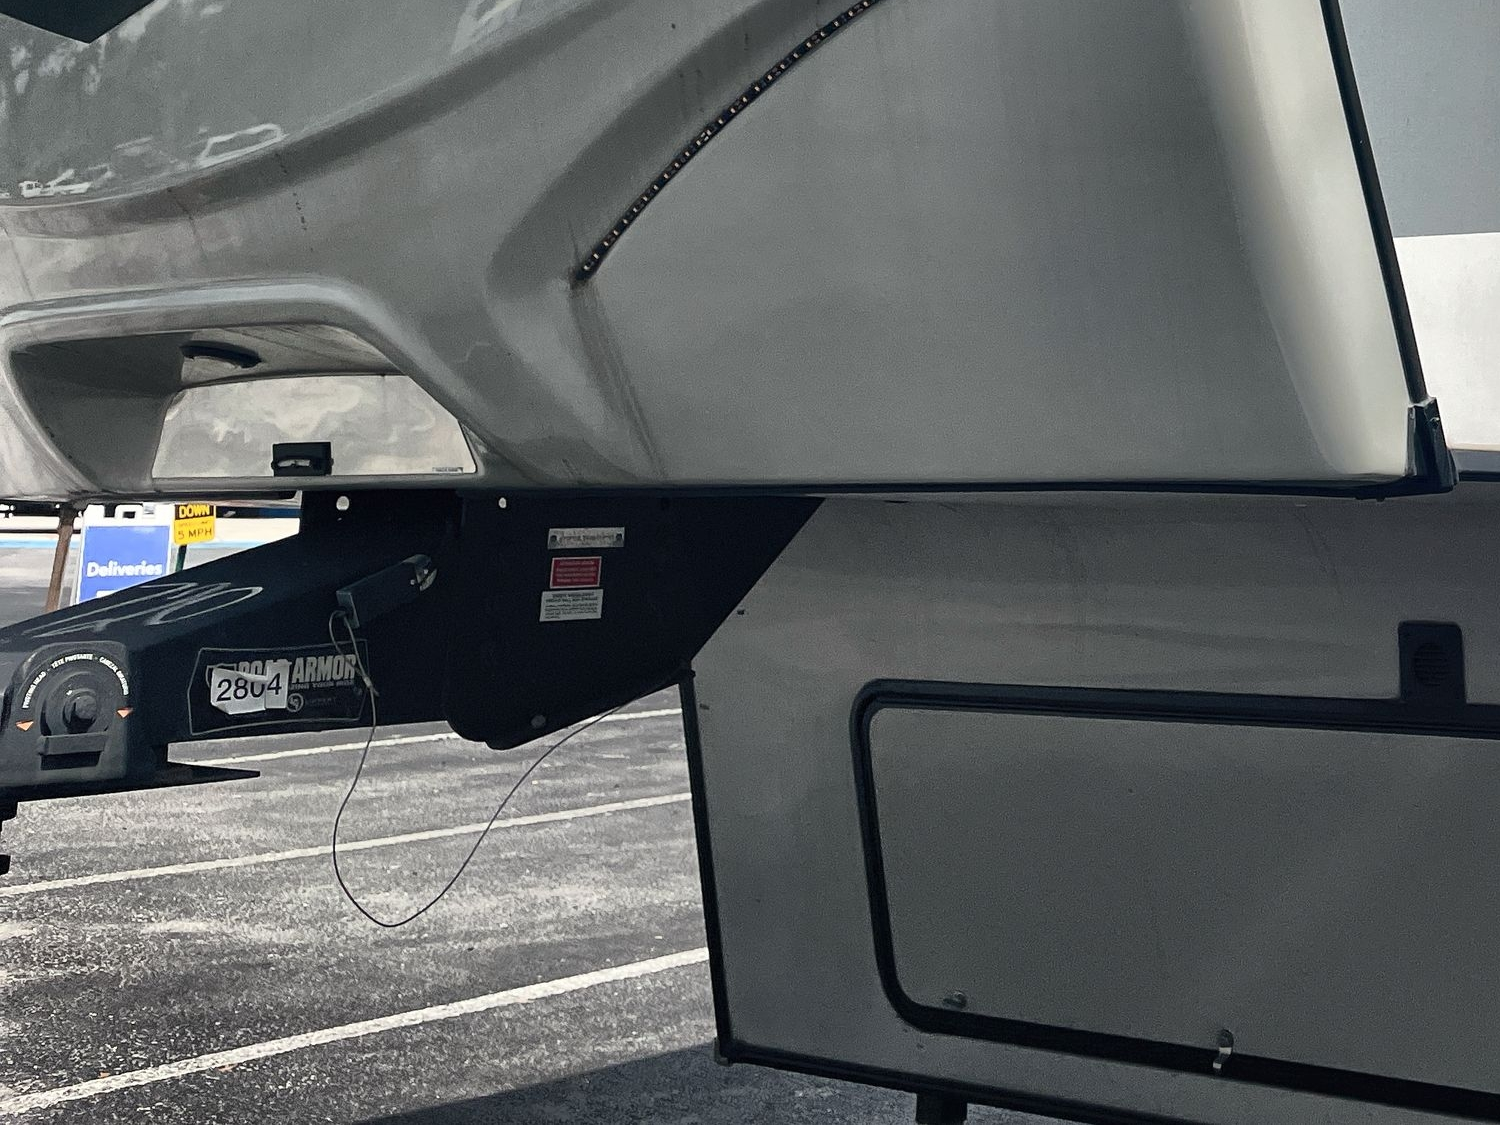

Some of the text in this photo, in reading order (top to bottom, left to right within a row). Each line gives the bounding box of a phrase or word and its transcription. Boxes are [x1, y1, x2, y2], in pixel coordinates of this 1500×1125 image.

[178, 504, 211, 519] DOWN
[188, 527, 213, 539] MPH
[86, 559, 163, 577] Deliveries
[291, 653, 357, 684] ARMOR
